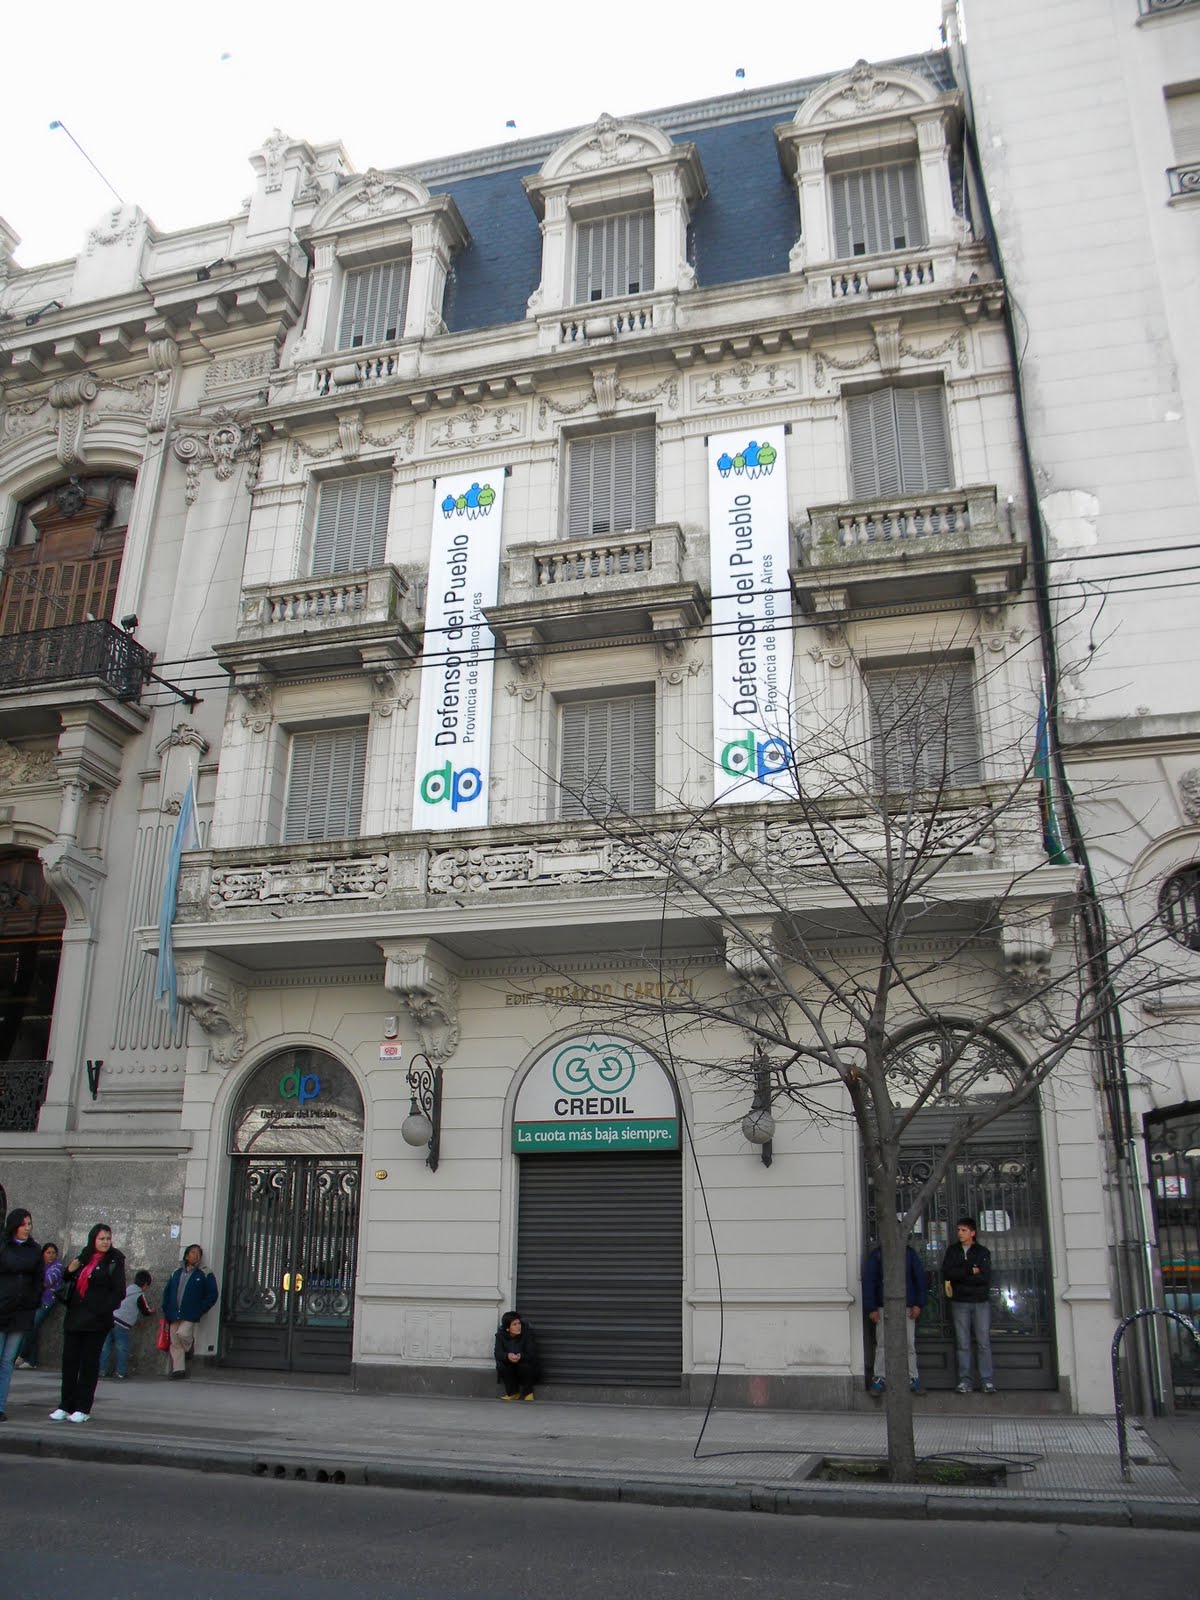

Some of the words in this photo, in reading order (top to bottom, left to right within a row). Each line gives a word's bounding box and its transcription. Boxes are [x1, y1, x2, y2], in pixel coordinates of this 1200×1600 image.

[728, 494, 753, 566] Pueblo
[444, 534, 469, 604] Pueblo
[729, 573, 755, 605] del
[761, 554, 774, 585] Aires
[442, 609, 465, 641] del
[469, 592, 482, 620] Aires
[762, 588, 776, 632] Buenos
[467, 623, 481, 667] Buenos
[733, 611, 758, 716] Defensor
[763, 636, 776, 650] de
[435, 647, 462, 746] Defensor
[466, 670, 478, 685] de
[764, 655, 778, 713] Provincia
[462, 688, 478, 743] Provincia
[420, 759, 483, 812] dp
[279, 1065, 321, 1105] dp
[554, 1096, 634, 1116] CREDIL
[517, 1129, 532, 1142] La
[534, 1129, 566, 1142] cuota
[568, 1127, 593, 1141] más
[595, 1127, 619, 1144] baja
[621, 1126, 672, 1143] siempre.
